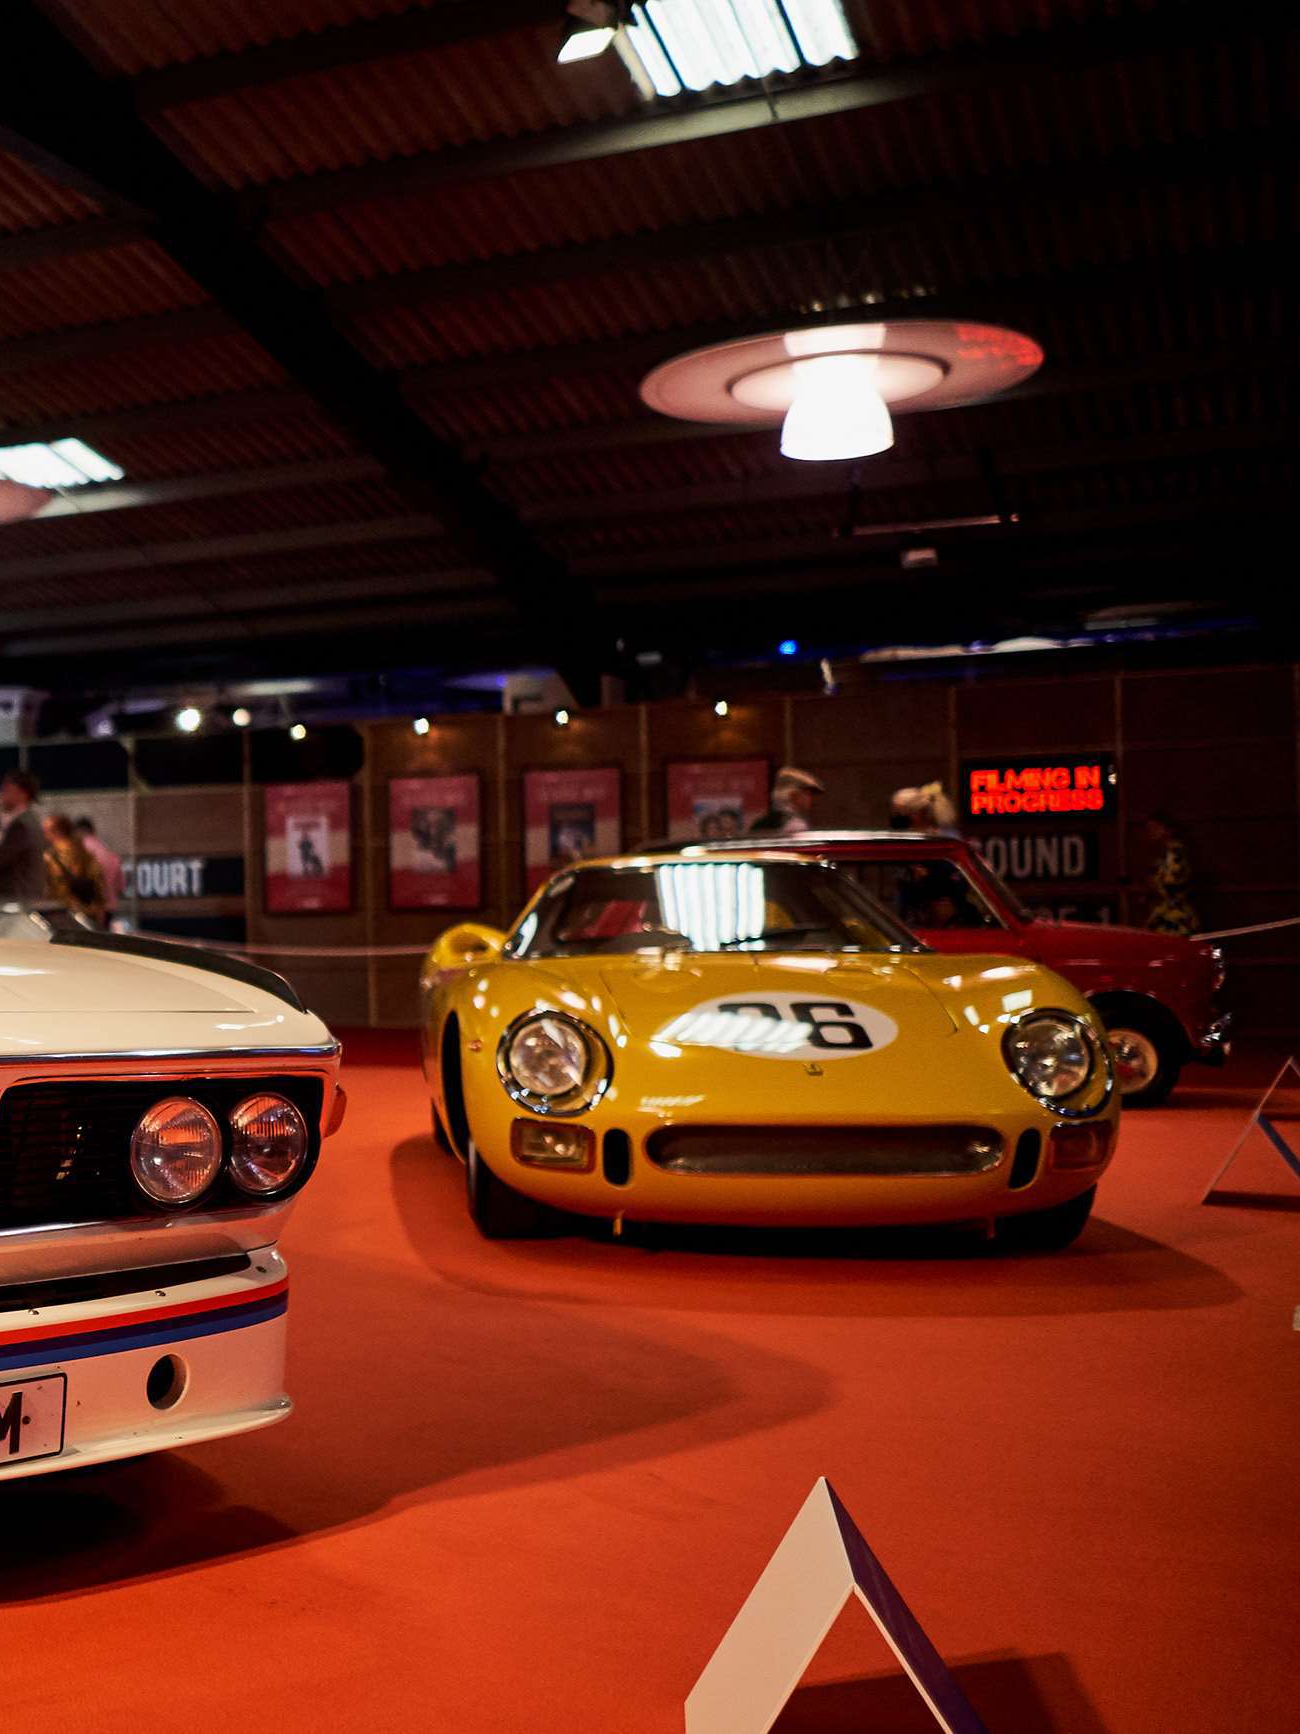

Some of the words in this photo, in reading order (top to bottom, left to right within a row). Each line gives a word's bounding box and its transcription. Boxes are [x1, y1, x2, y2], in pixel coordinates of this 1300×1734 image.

[970, 767, 1070, 792] FILMING
[1074, 765, 1101, 790] IN
[970, 788, 1104, 814] PROGRESS
